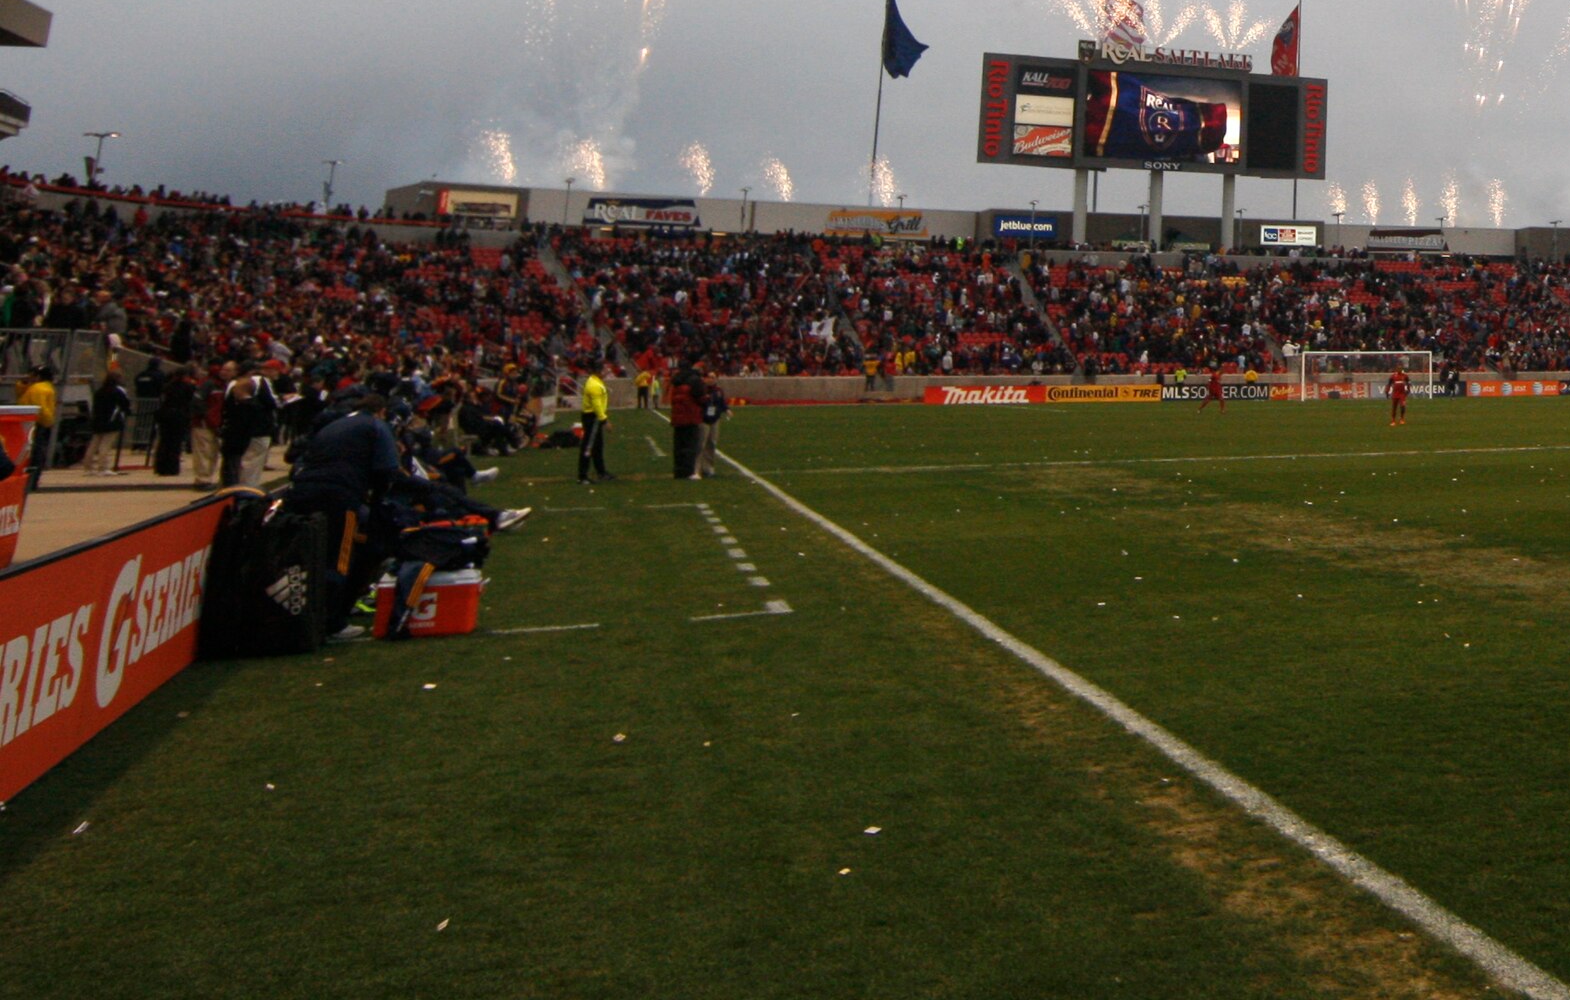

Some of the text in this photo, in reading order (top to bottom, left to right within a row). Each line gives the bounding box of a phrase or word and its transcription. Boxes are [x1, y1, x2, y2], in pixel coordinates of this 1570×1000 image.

[1155, 47, 1201, 66] SALT
[1203, 51, 1253, 72] LAKE
[983, 61, 1009, 157] Rio Tinto
[1304, 83, 1324, 173] Rio Tinto
[1013, 127, 1072, 155] Budweiser
[1144, 161, 1180, 170] SONY
[645, 208, 692, 223] FAVES
[887, 215, 922, 235] Grill
[999, 220, 1053, 232] jetbluecom
[1047, 386, 1160, 401] Continental TIRE
[1162, 386, 1268, 399] MLSSOER.COM
[1378, 385, 1445, 394] VWAGEN
[287, 564, 307, 616] adidas
[0, 601, 95, 748] RIES
